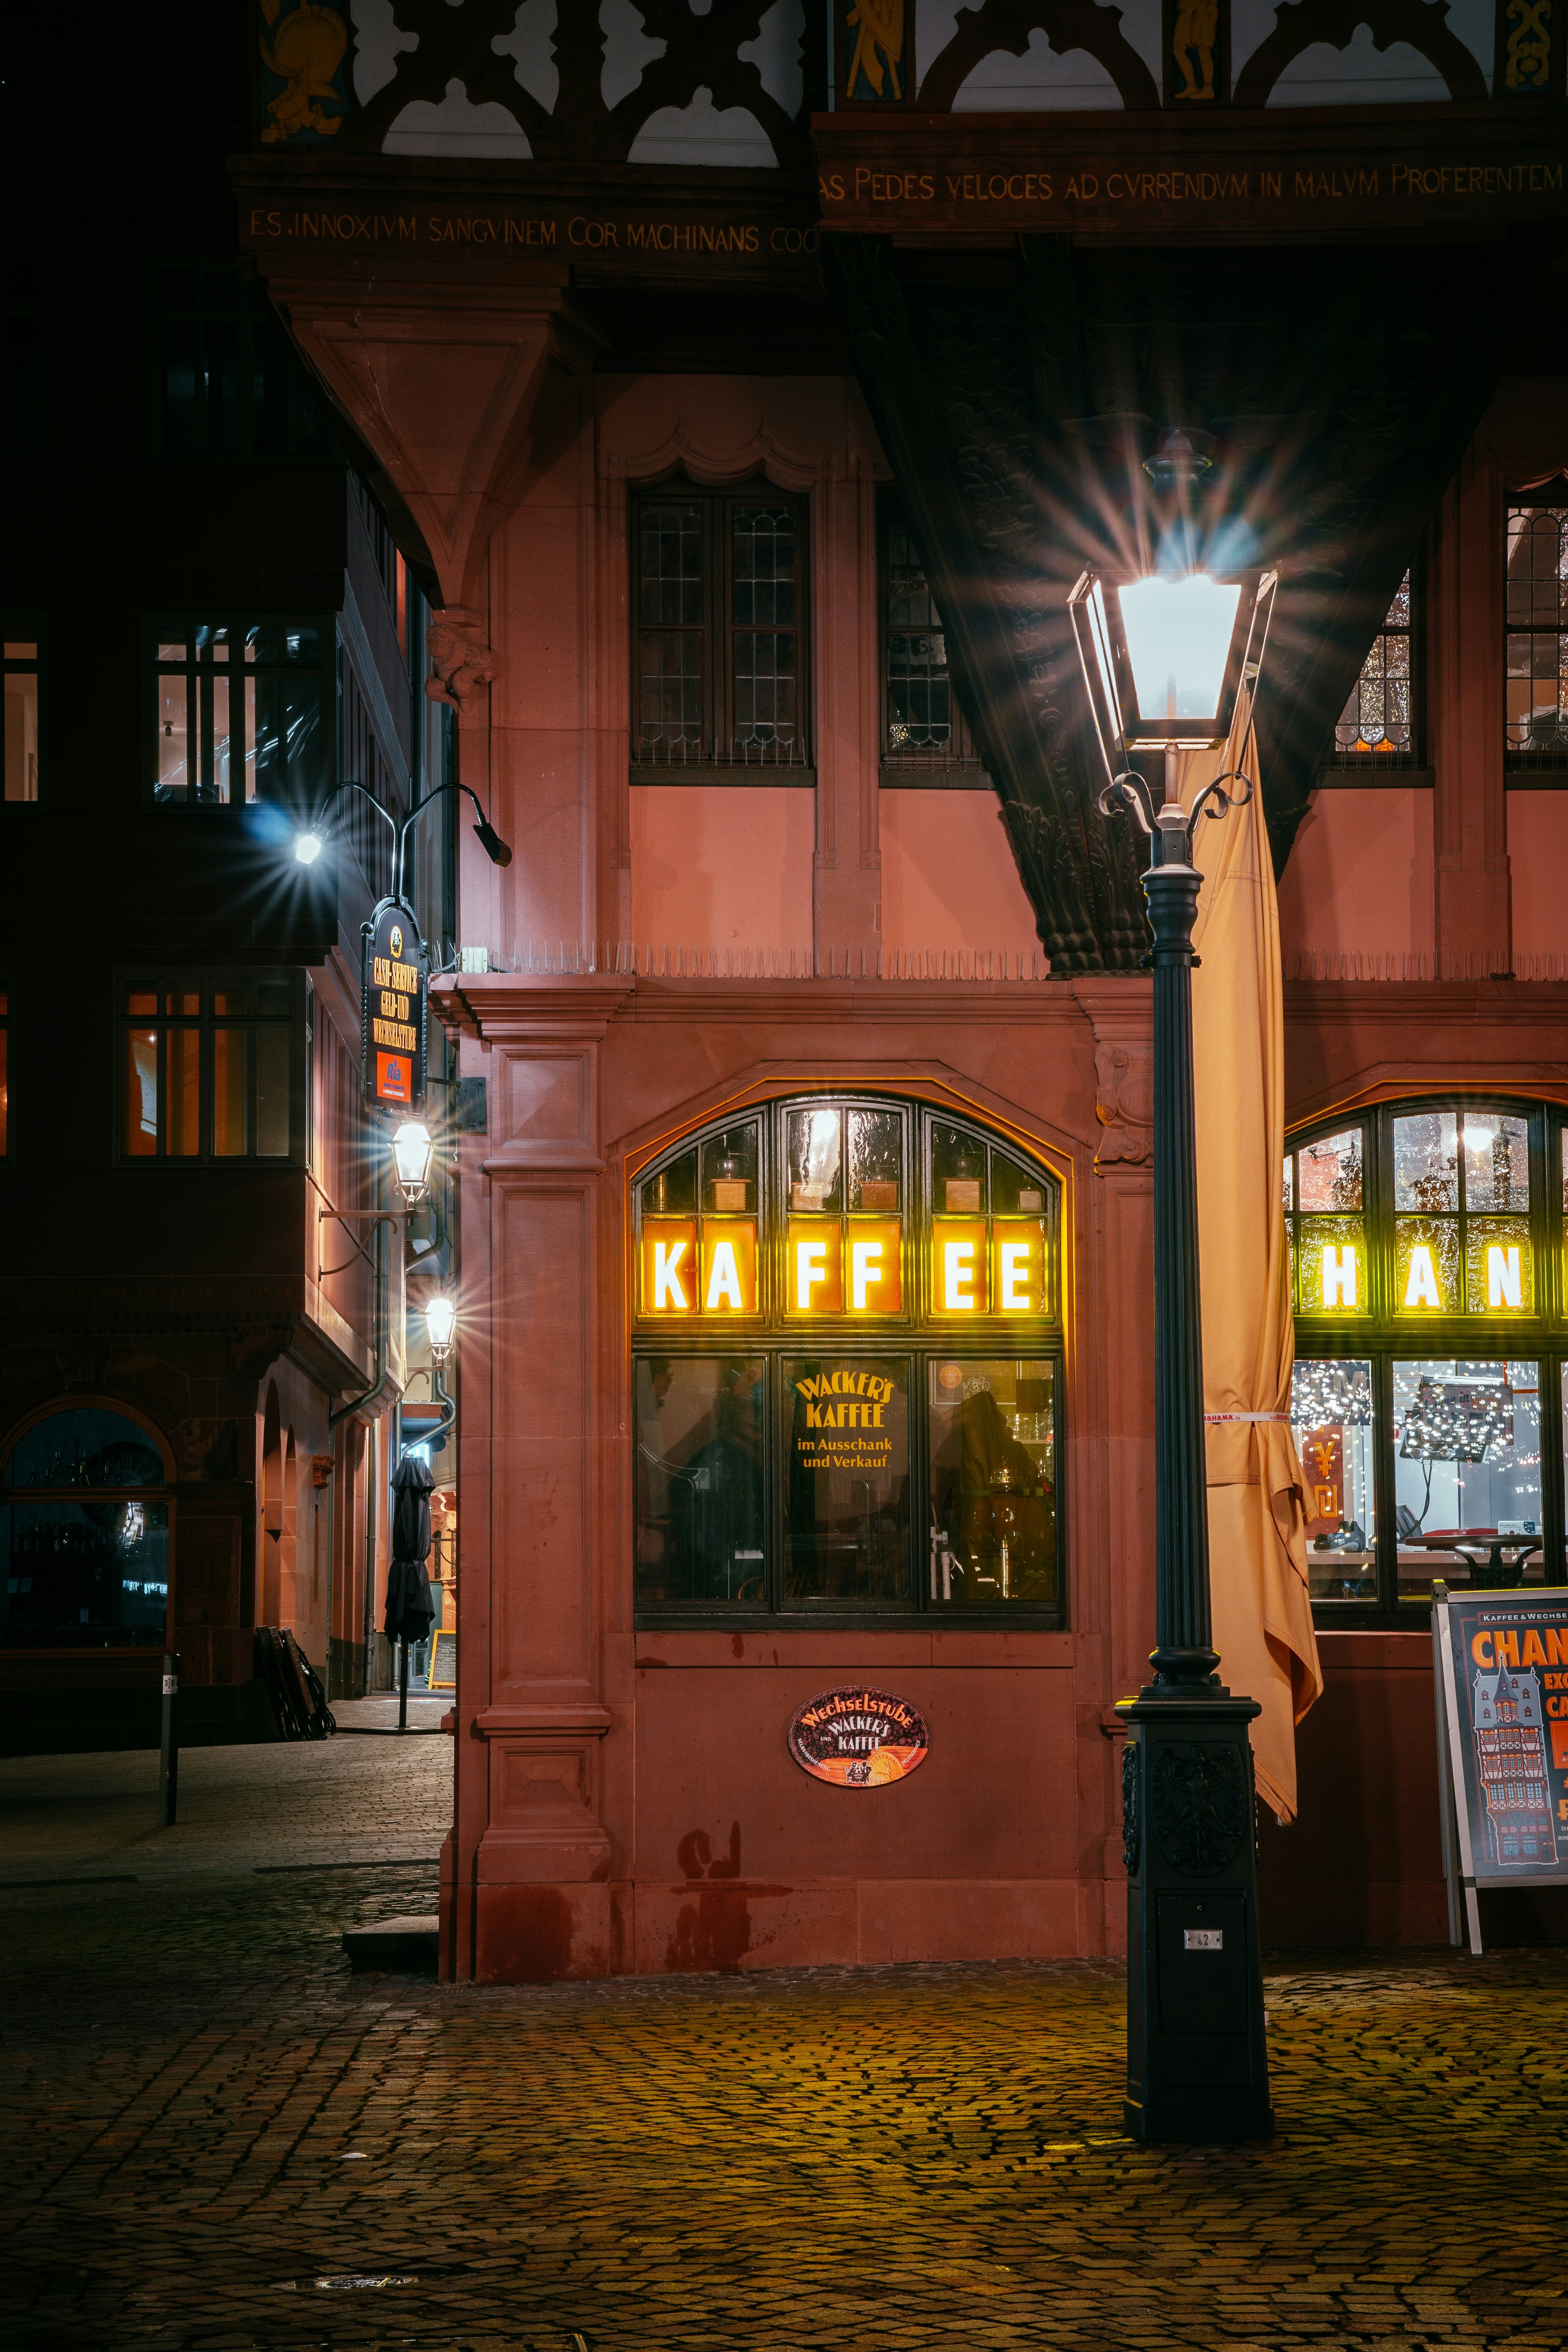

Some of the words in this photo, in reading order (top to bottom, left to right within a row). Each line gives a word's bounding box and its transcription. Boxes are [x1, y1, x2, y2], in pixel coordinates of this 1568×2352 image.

[855, 167, 934, 201] PEDES
[946, 174, 1053, 201] VELOCES
[1065, 174, 1099, 199] AD
[1106, 172, 1248, 200] CVRRENDVM
[1260, 172, 1281, 197] IN
[1294, 170, 1379, 197] MALVM
[1391, 162, 1563, 195] PROFERENTEM
[428, 217, 556, 246] SANGVINEM
[568, 216, 619, 248] COR
[627, 223, 759, 252] MACHINANS
[374, 956, 417, 994] CASH-SERVICE
[380, 990, 410, 1021] GELD-UND
[372, 1017, 416, 1051] WECHSELSTUBE
[387, 1059, 401, 1081] Ria
[655, 1242, 1030, 1309] KAFFEE
[796, 1371, 895, 1404] WACKER'S
[807, 1403, 884, 1428] KAFFEE
[798, 1438, 815, 1450] im
[818, 1437, 892, 1450] Ausschank
[804, 1455, 830, 1467] und
[833, 1455, 887, 1467] Verkauf
[827, 1716, 890, 1737] WACKER'S
[798, 1738, 831, 1772] SELBSTBEDIENUNG
[839, 1736, 881, 1750] KAFFEE
[901, 1740, 921, 1765] SELFSERVICE
